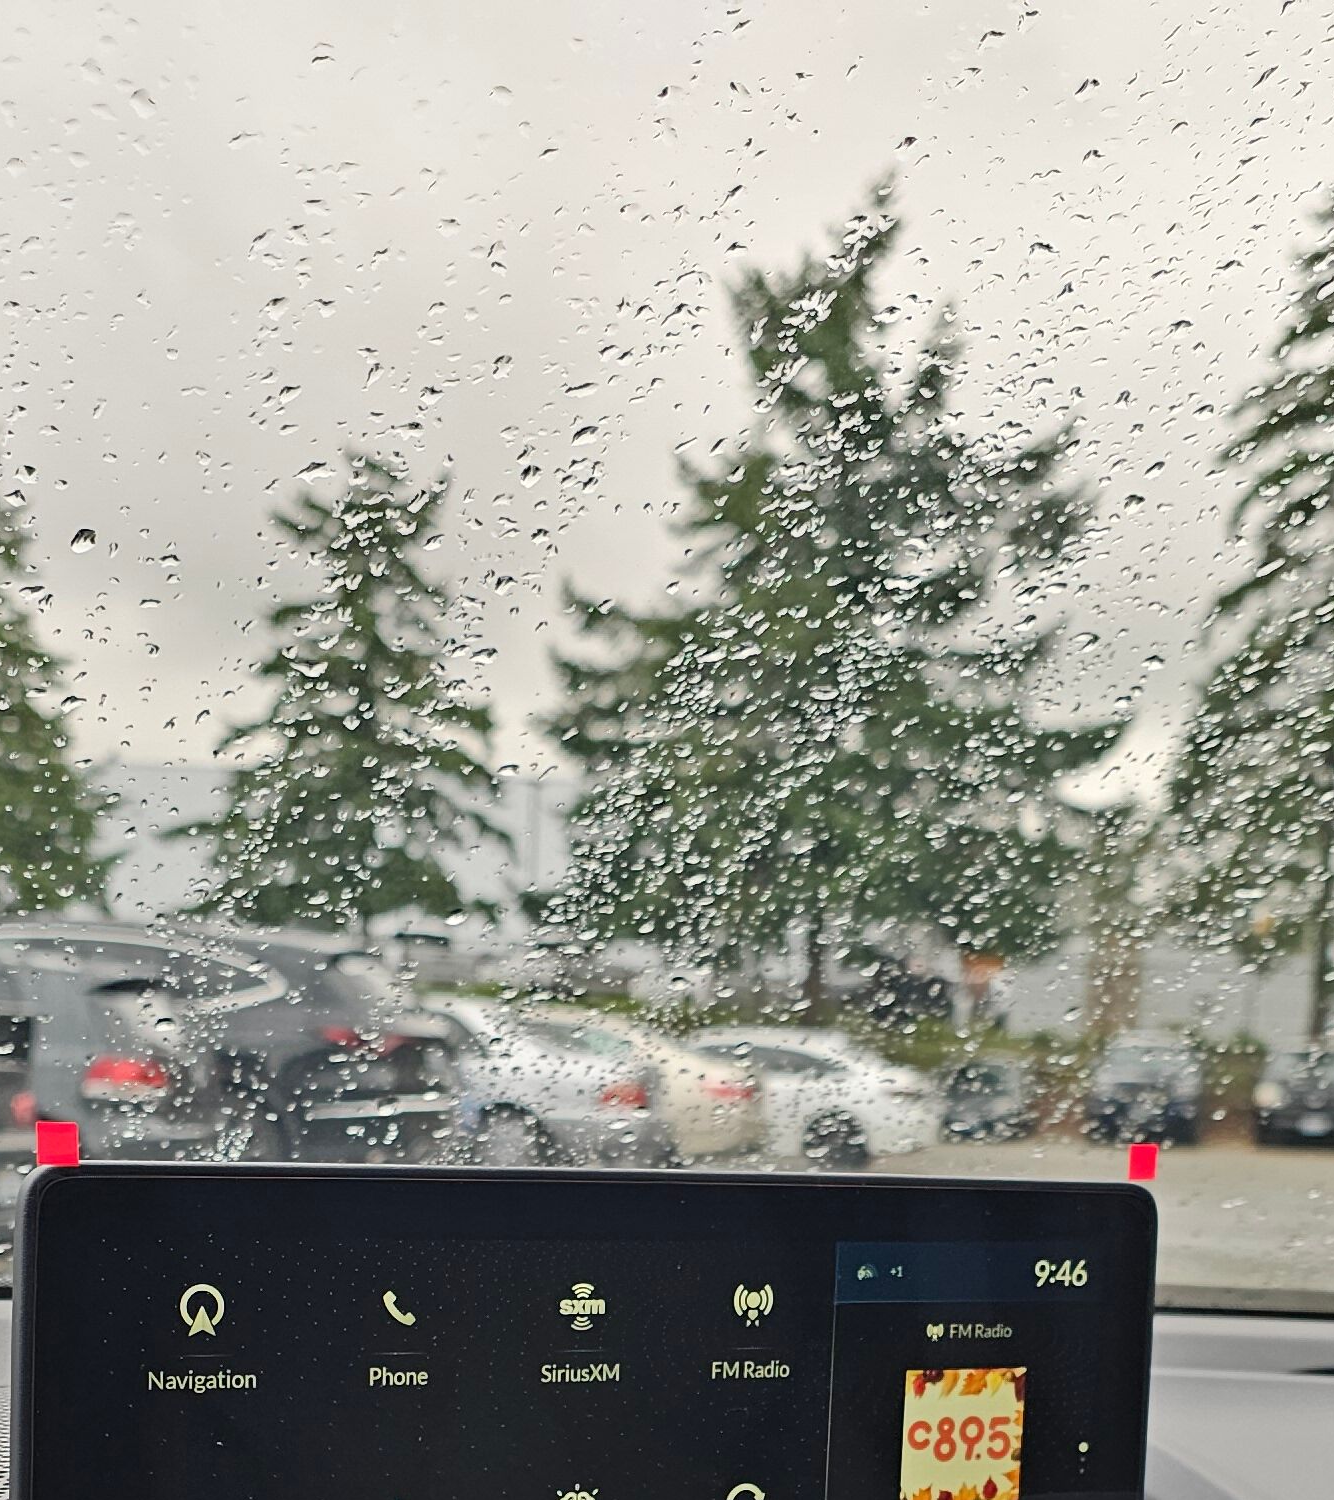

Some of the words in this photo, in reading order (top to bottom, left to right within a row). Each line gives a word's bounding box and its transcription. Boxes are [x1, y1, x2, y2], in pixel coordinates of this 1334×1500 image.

[1034, 1259, 1089, 1288] 9:46
[949, 1323, 972, 1339] FM
[974, 1322, 1013, 1339] Radio
[368, 1365, 430, 1388] Phone
[540, 1361, 622, 1384] SiriusXM
[710, 1360, 740, 1380] FM
[743, 1358, 791, 1380] Radio
[146, 1368, 258, 1394] Navigation
